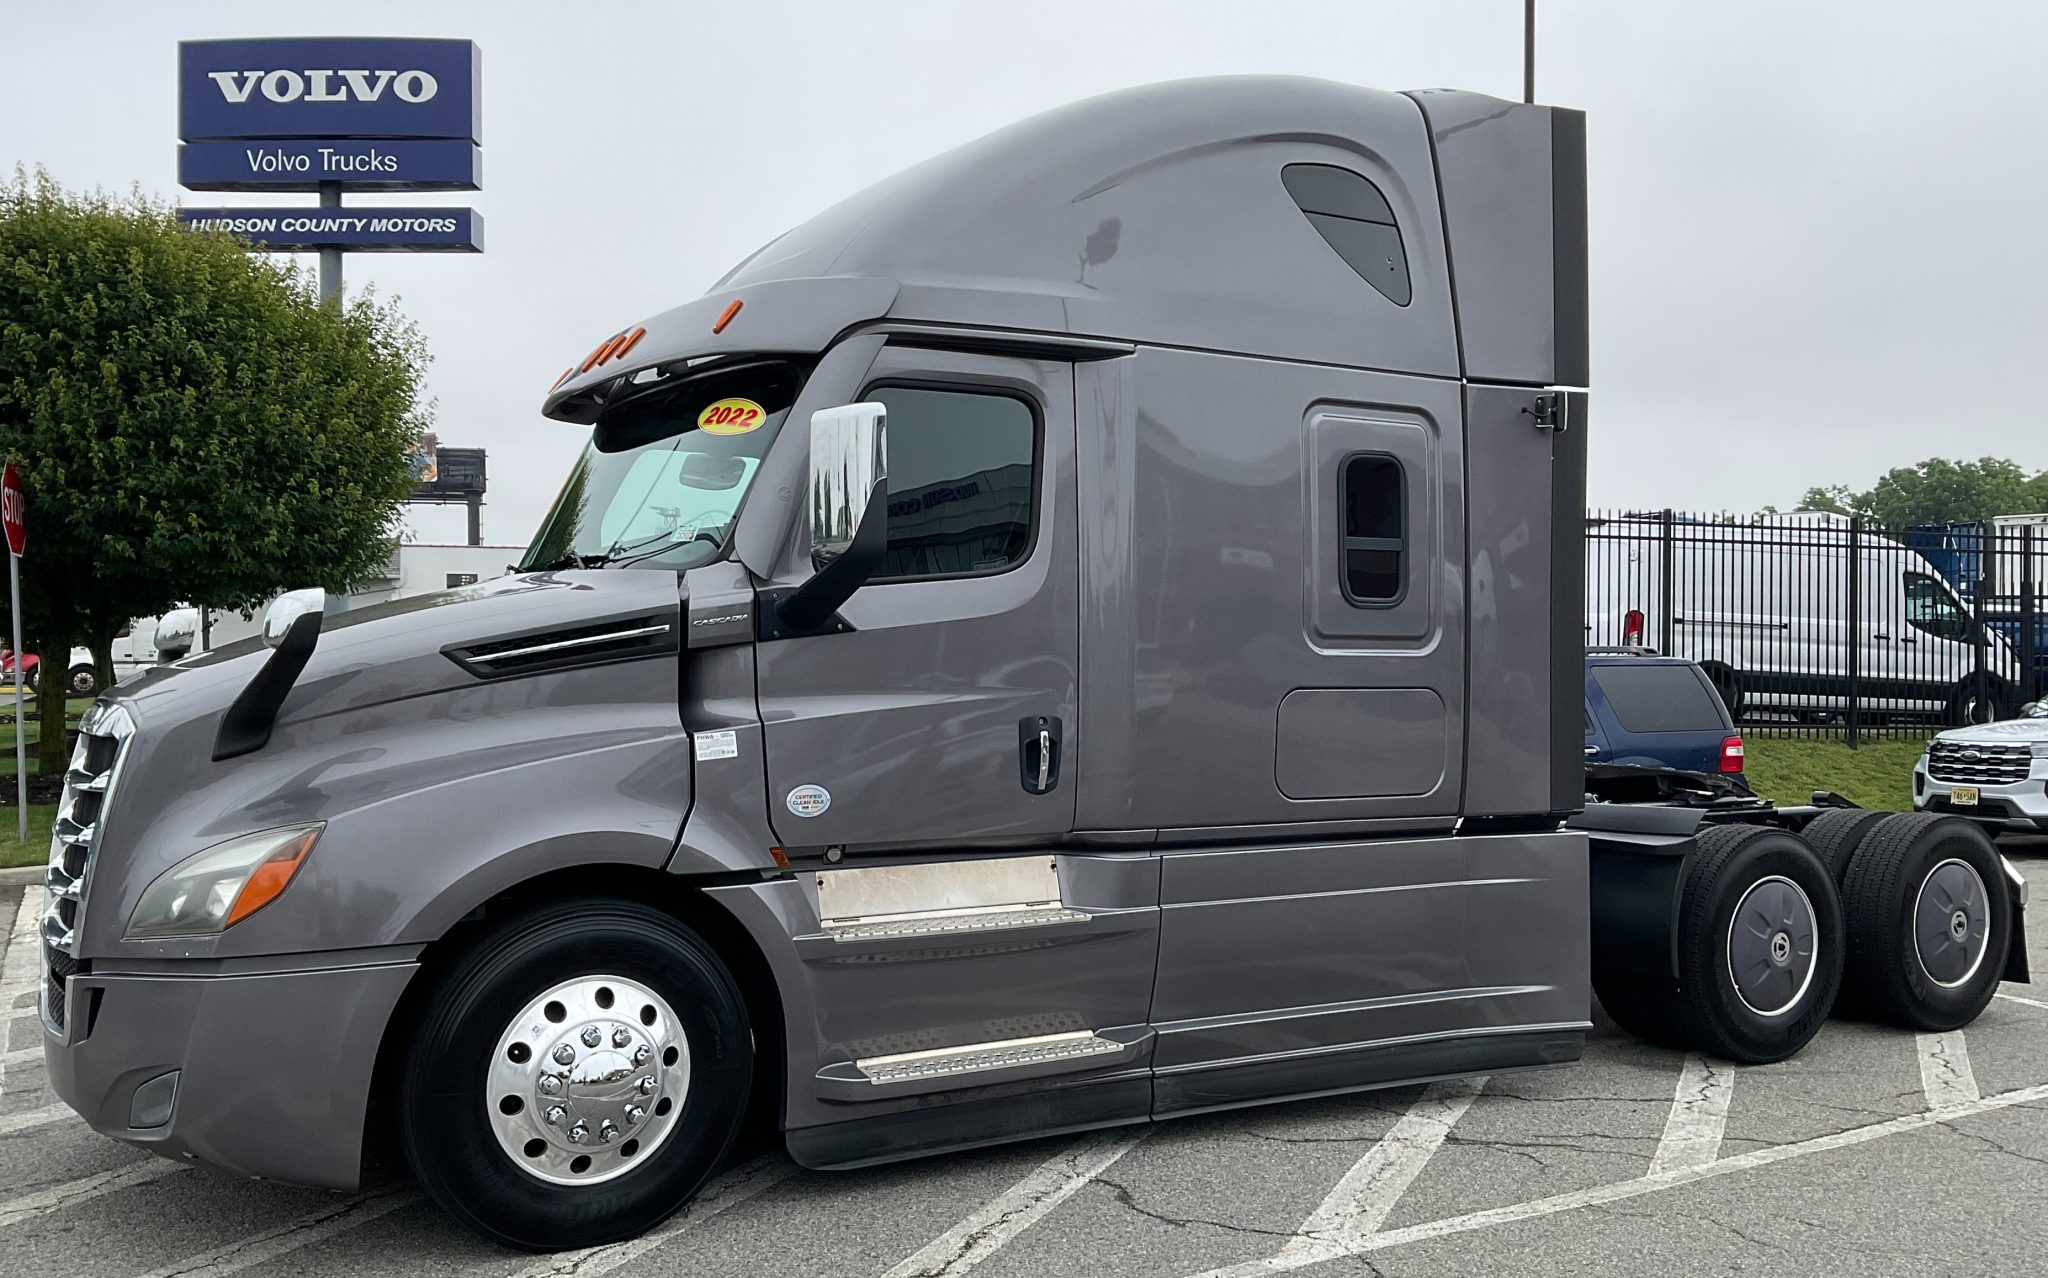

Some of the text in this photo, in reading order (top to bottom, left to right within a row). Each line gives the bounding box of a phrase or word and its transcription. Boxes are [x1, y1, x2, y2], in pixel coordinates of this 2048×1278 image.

[207, 69, 438, 103] VOLVO
[246, 148, 398, 172] Volvo Trucks
[280, 217, 367, 233] COUNTY
[369, 217, 457, 233] MOTORS
[702, 406, 759, 427] 2022
[4, 486, 25, 527] STOP
[693, 614, 748, 626] CASCADIA
